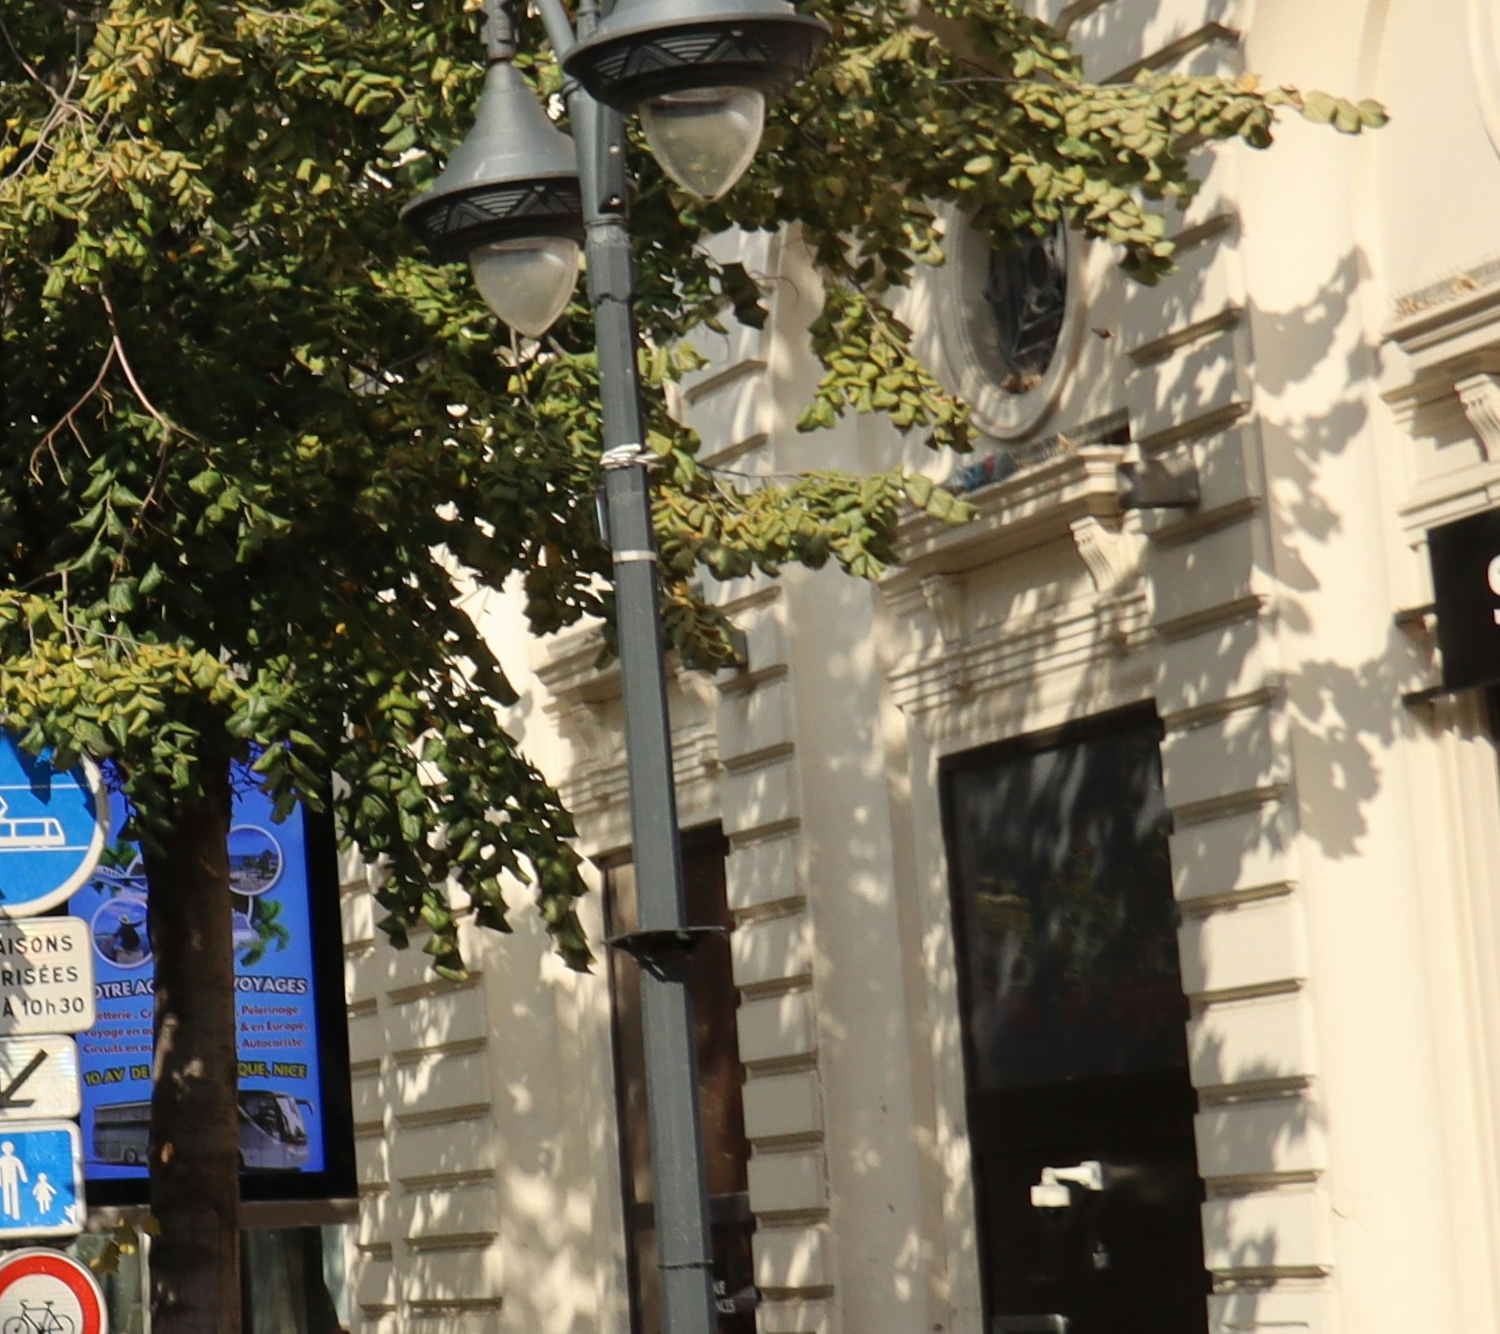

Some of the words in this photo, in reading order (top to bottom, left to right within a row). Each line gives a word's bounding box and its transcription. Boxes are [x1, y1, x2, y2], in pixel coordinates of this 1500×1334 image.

[3, 995, 15, 1018] À
[237, 1062, 270, 1077] QUE,
[273, 1063, 306, 1078] NICE
